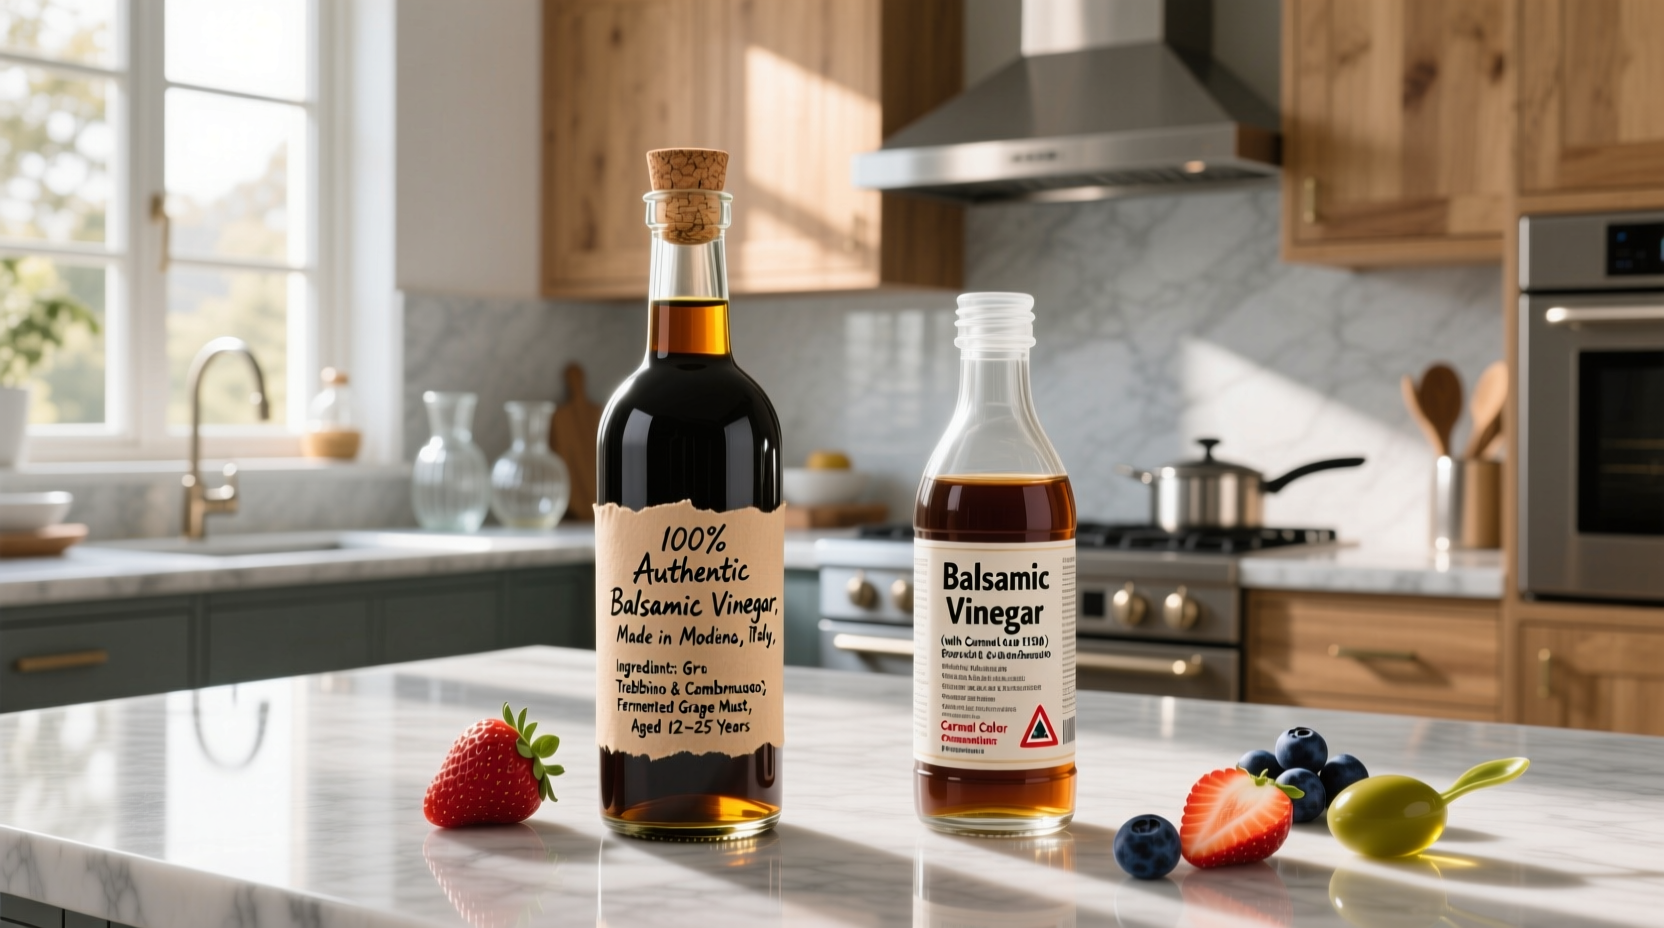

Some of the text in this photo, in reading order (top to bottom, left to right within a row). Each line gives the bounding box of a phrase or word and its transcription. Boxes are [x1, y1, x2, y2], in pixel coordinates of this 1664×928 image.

[662, 524, 726, 554] 100%
[633, 552, 750, 585] Authentic
[943, 562, 1050, 591] Balsamic
[610, 586, 778, 624] Balsamic Vinegar,
[946, 596, 1044, 635] Vinegar
[617, 624, 652, 644] Made
[658, 630, 672, 645] in
[671, 682, 680, 696] &
[718, 699, 752, 715] Must,
[632, 718, 662, 738] Aged
[716, 718, 750, 736] Years
